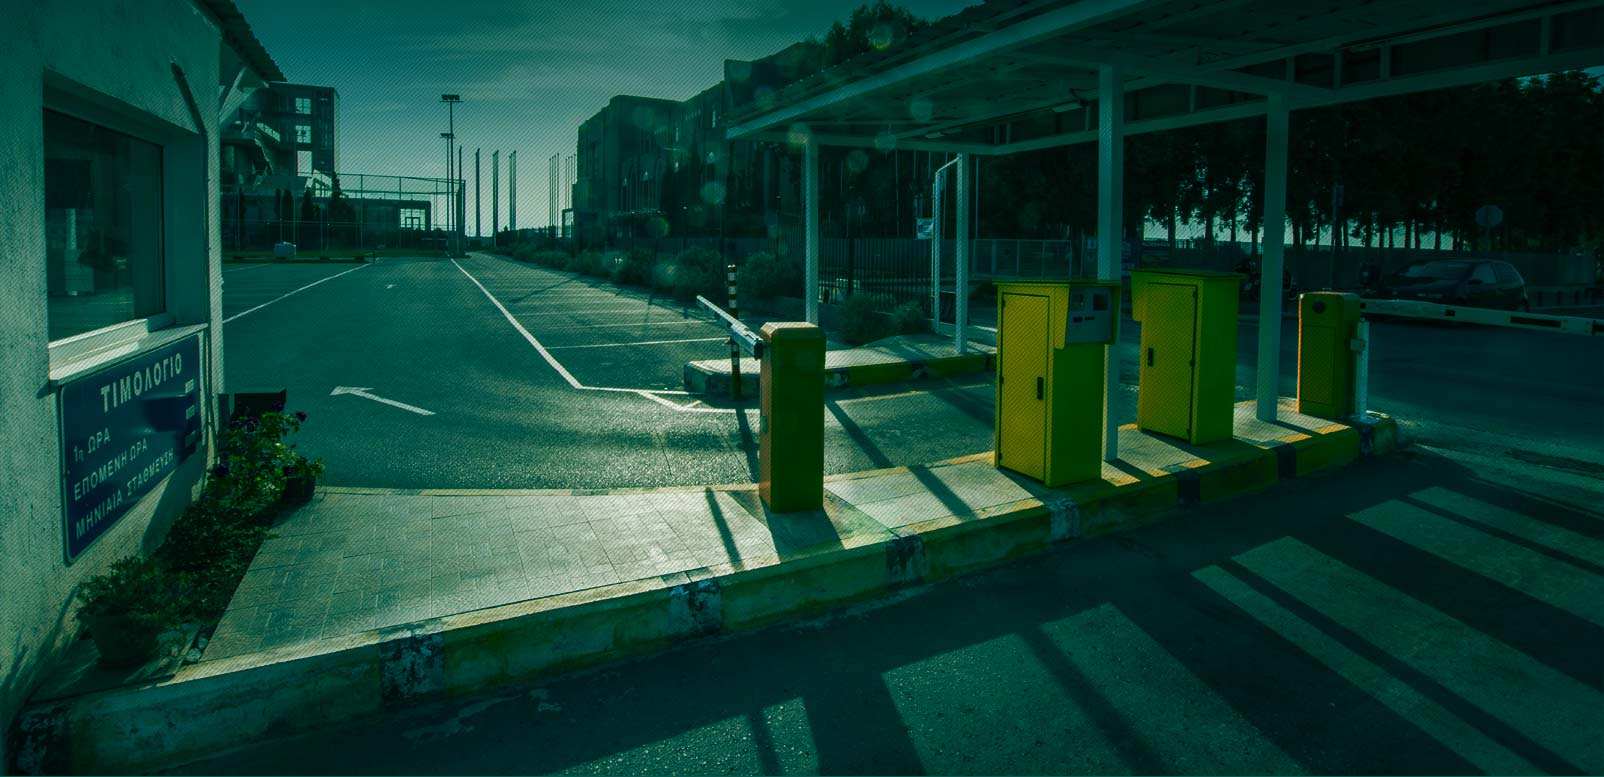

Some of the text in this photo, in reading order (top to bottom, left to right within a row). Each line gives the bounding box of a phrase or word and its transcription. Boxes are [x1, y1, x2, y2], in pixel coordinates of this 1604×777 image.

[101, 353, 182, 413] ΤΙΜΟΛΟΓΙΟ
[75, 451, 127, 501] ΕΠΟΜΕΝΗ
[129, 438, 148, 464] ΩΡΑ
[88, 427, 111, 454] ΩΡΑ
[76, 449, 174, 539] ΜΗΝΙΑΙΑ ΣΤΑΘΜΕΥΣΗ
